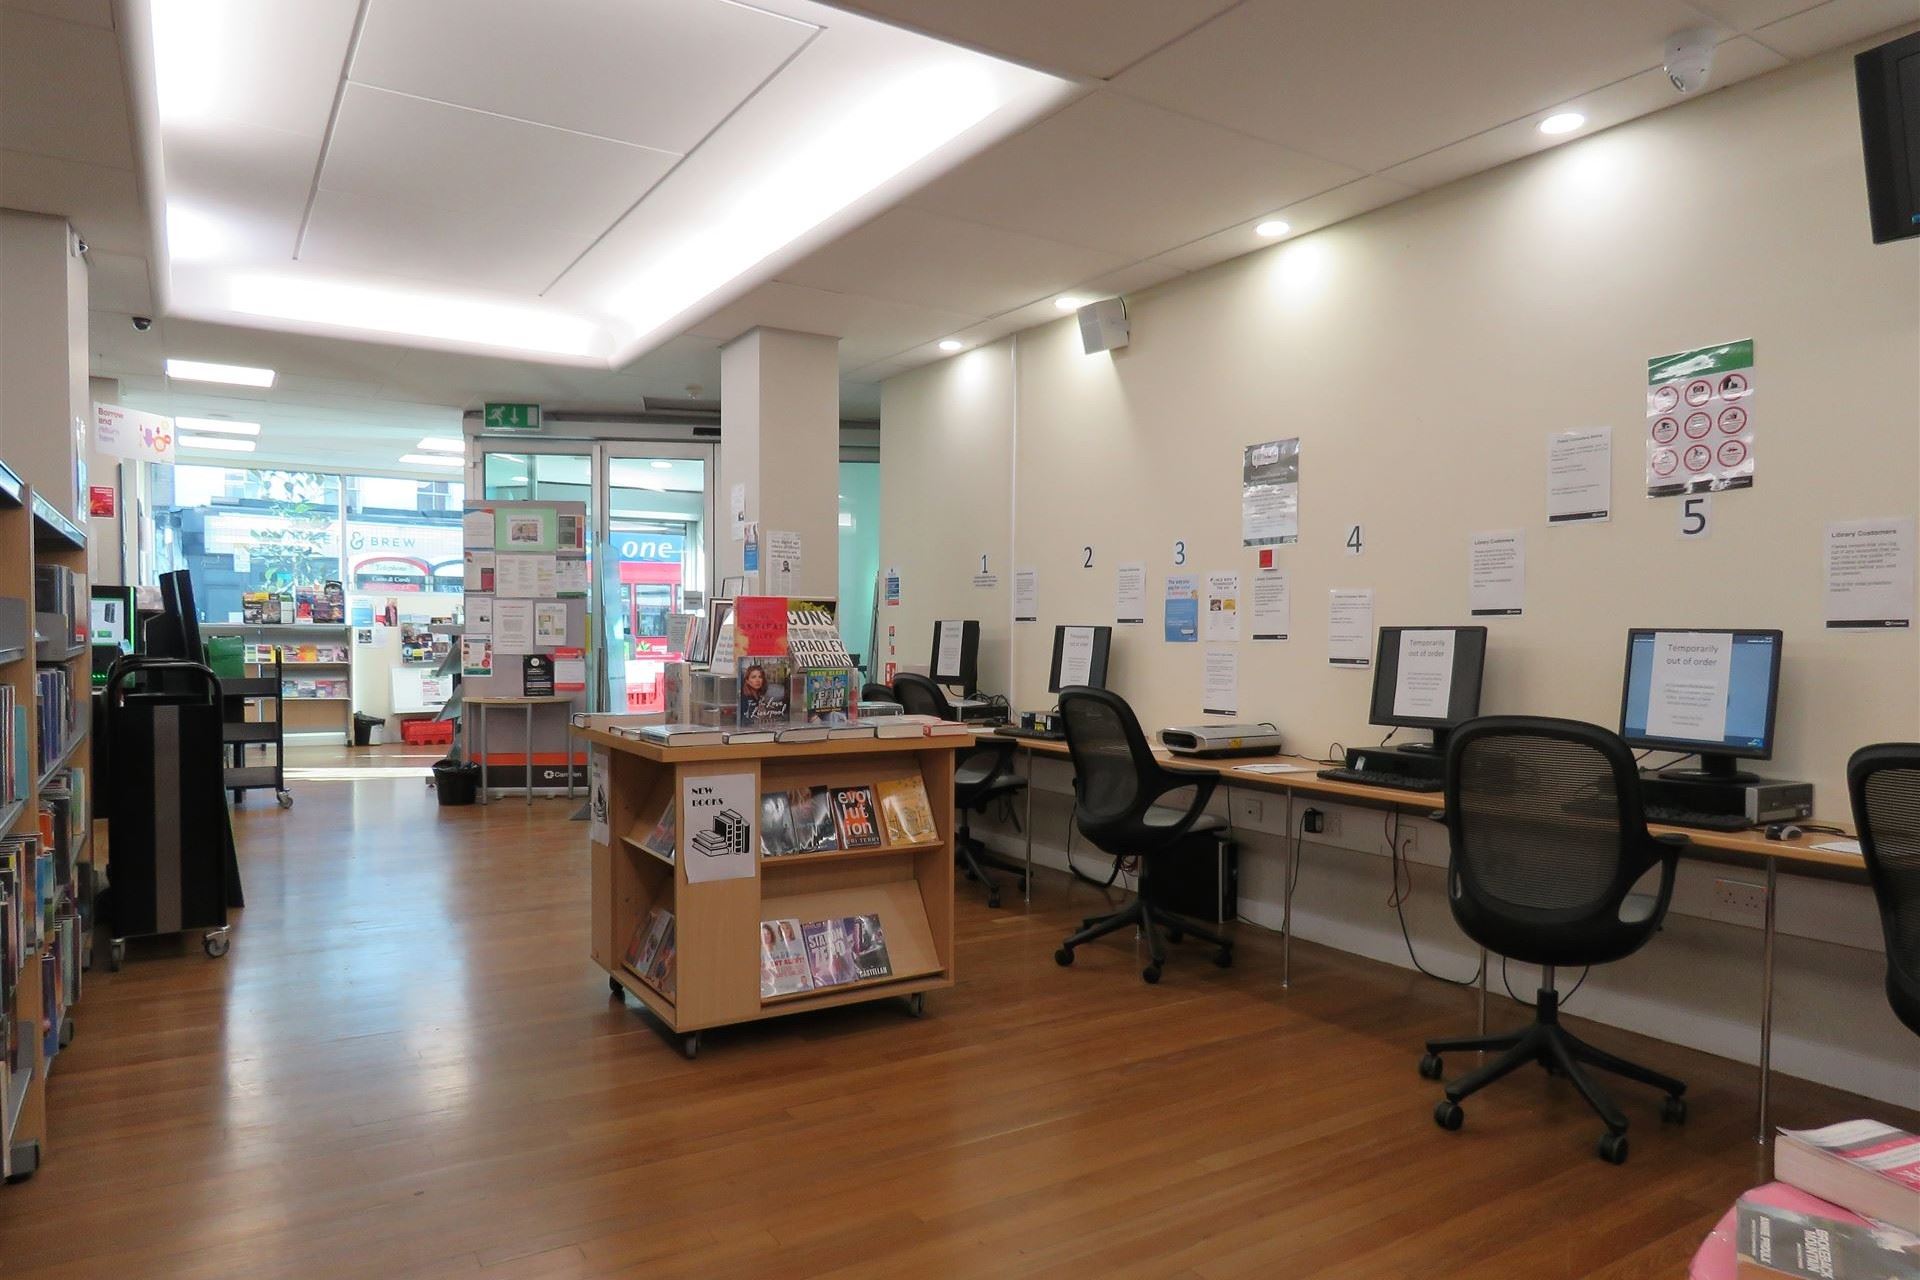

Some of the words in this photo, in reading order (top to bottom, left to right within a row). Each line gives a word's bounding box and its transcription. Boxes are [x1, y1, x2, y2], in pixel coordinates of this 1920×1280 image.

[98, 407, 123, 418] Borrow
[1683, 498, 1706, 534] 5
[350, 531, 364, 550] &
[370, 536, 416, 547] BREW
[1346, 525, 1362, 553] 4
[1831, 530, 1856, 539] Library
[1857, 528, 1897, 536] Customers
[622, 537, 673, 559] one
[1174, 541, 1185, 565] 3
[981, 554, 988, 574] 1
[1084, 547, 1093, 568] 2
[790, 640, 845, 653] BRADLEY
[1409, 639, 1446, 647] Temporarily
[1668, 644, 1719, 654] Temporarily
[796, 653, 853, 667] WIGGINS
[1666, 657, 1681, 665] out
[1682, 656, 1692, 665] of
[1693, 657, 1718, 666] order
[766, 696, 783, 708] Love
[751, 704, 787, 719] Liverpool
[691, 787, 714, 795] NEW
[691, 798, 724, 807] BOOKS
[845, 820, 873, 836] ion
[1804, 1229, 1821, 1273] MOUNTAIN
[1815, 1228, 1834, 1280] BROKEBACK
